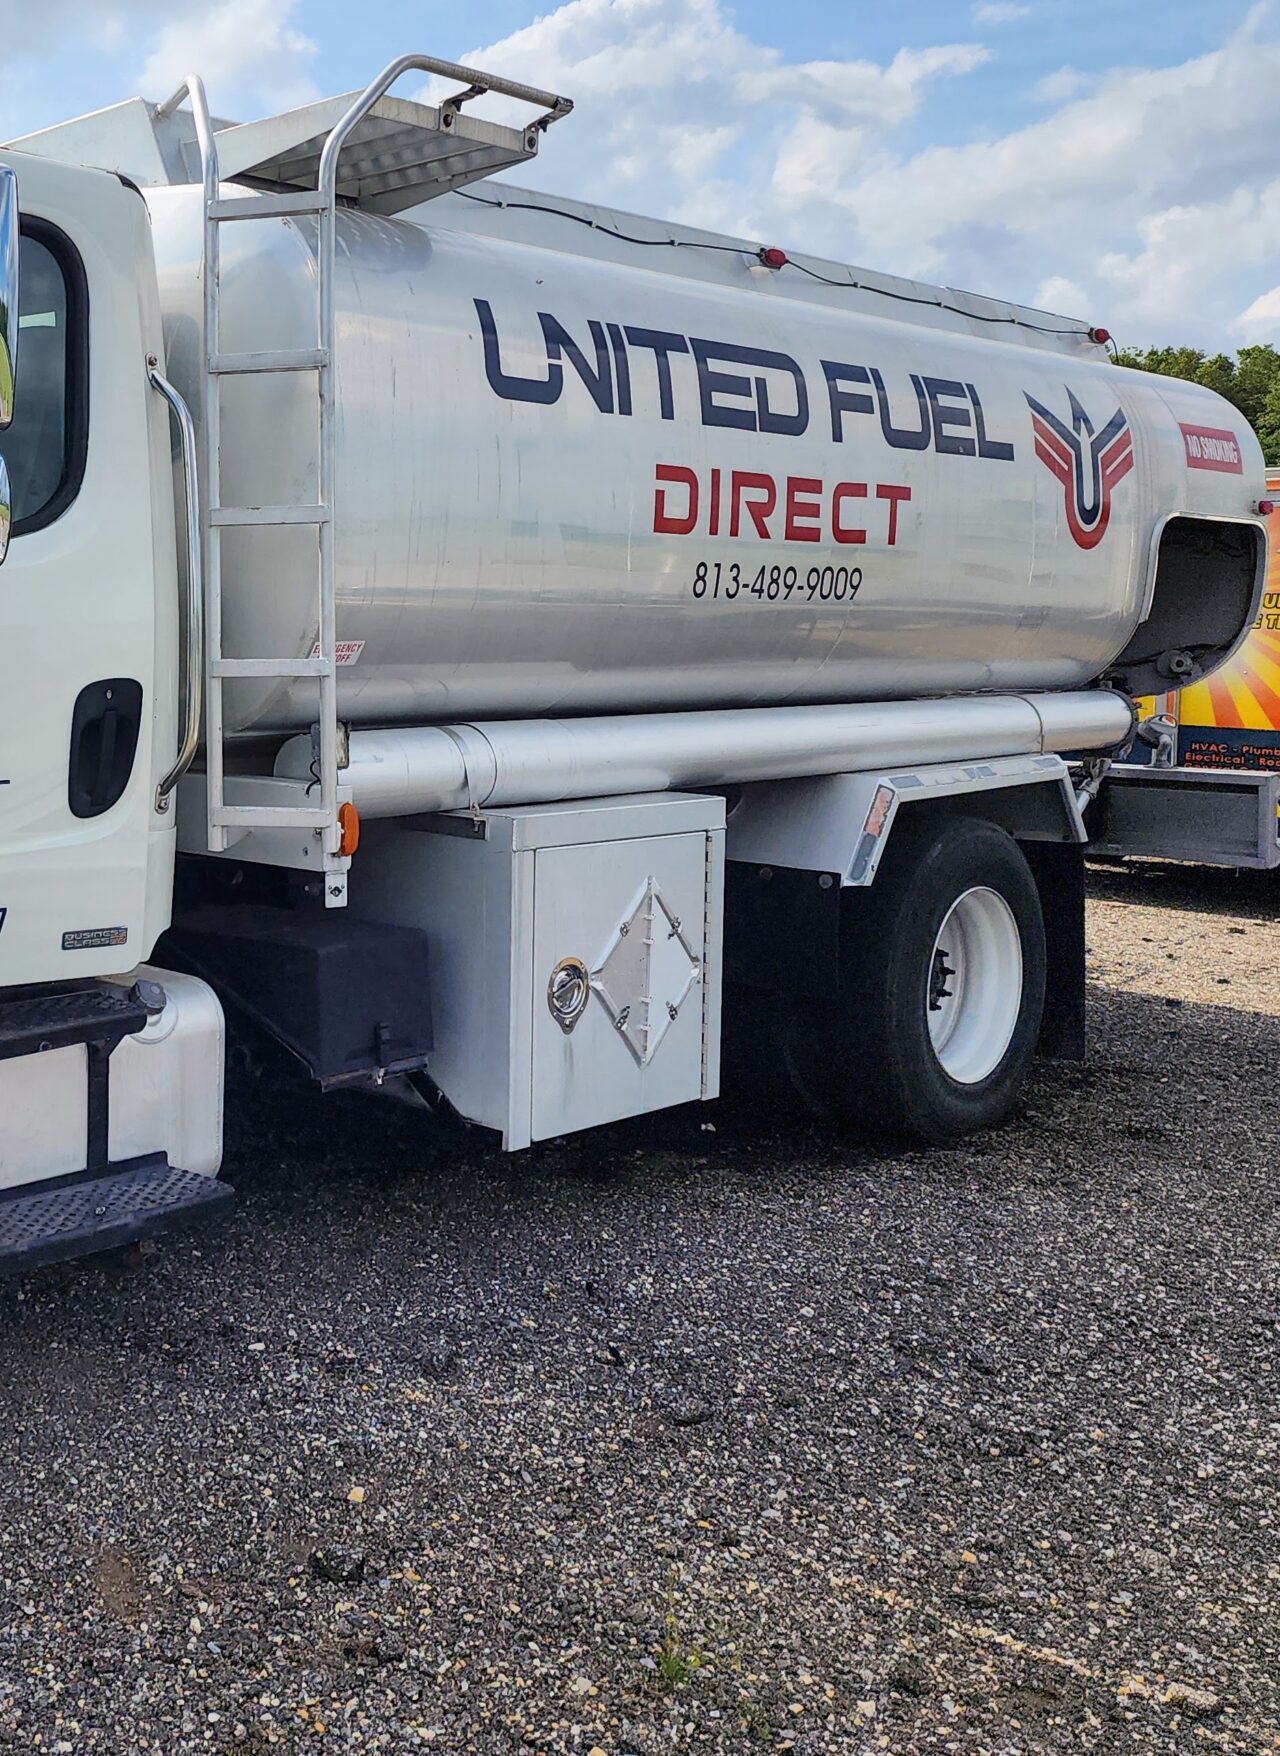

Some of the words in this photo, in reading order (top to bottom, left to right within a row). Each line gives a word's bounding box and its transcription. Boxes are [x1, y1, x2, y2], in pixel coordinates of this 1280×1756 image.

[473, 298, 809, 436] UNITED
[819, 359, 1014, 462] FUEL
[1186, 434, 1201, 457] NO
[1201, 437, 1237, 463] SMOKING
[653, 463, 911, 545] DIRECT
[692, 561, 863, 602] 813-489-9009
[313, 643, 362, 653] EGENCY
[1185, 752, 1244, 764] Electrical
[1191, 742, 1228, 752] HVAC
